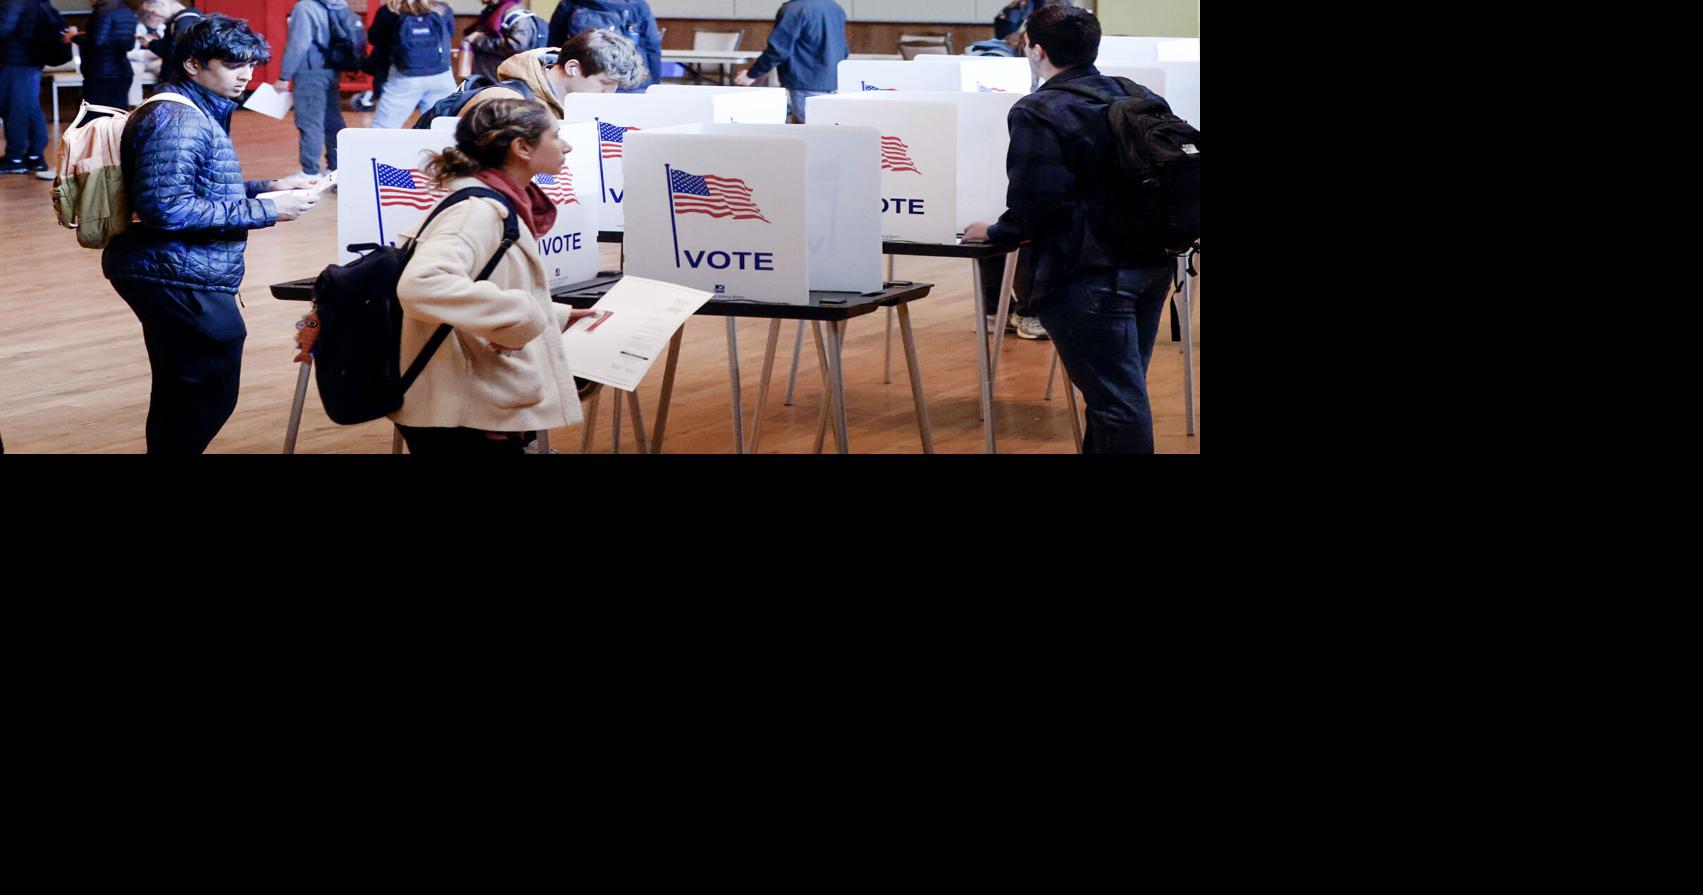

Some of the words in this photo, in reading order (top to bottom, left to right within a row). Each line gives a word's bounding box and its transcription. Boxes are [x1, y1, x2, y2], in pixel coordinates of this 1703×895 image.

[881, 197, 925, 215] TE
[542, 232, 582, 256] VOTE
[683, 249, 774, 271] VOTE
